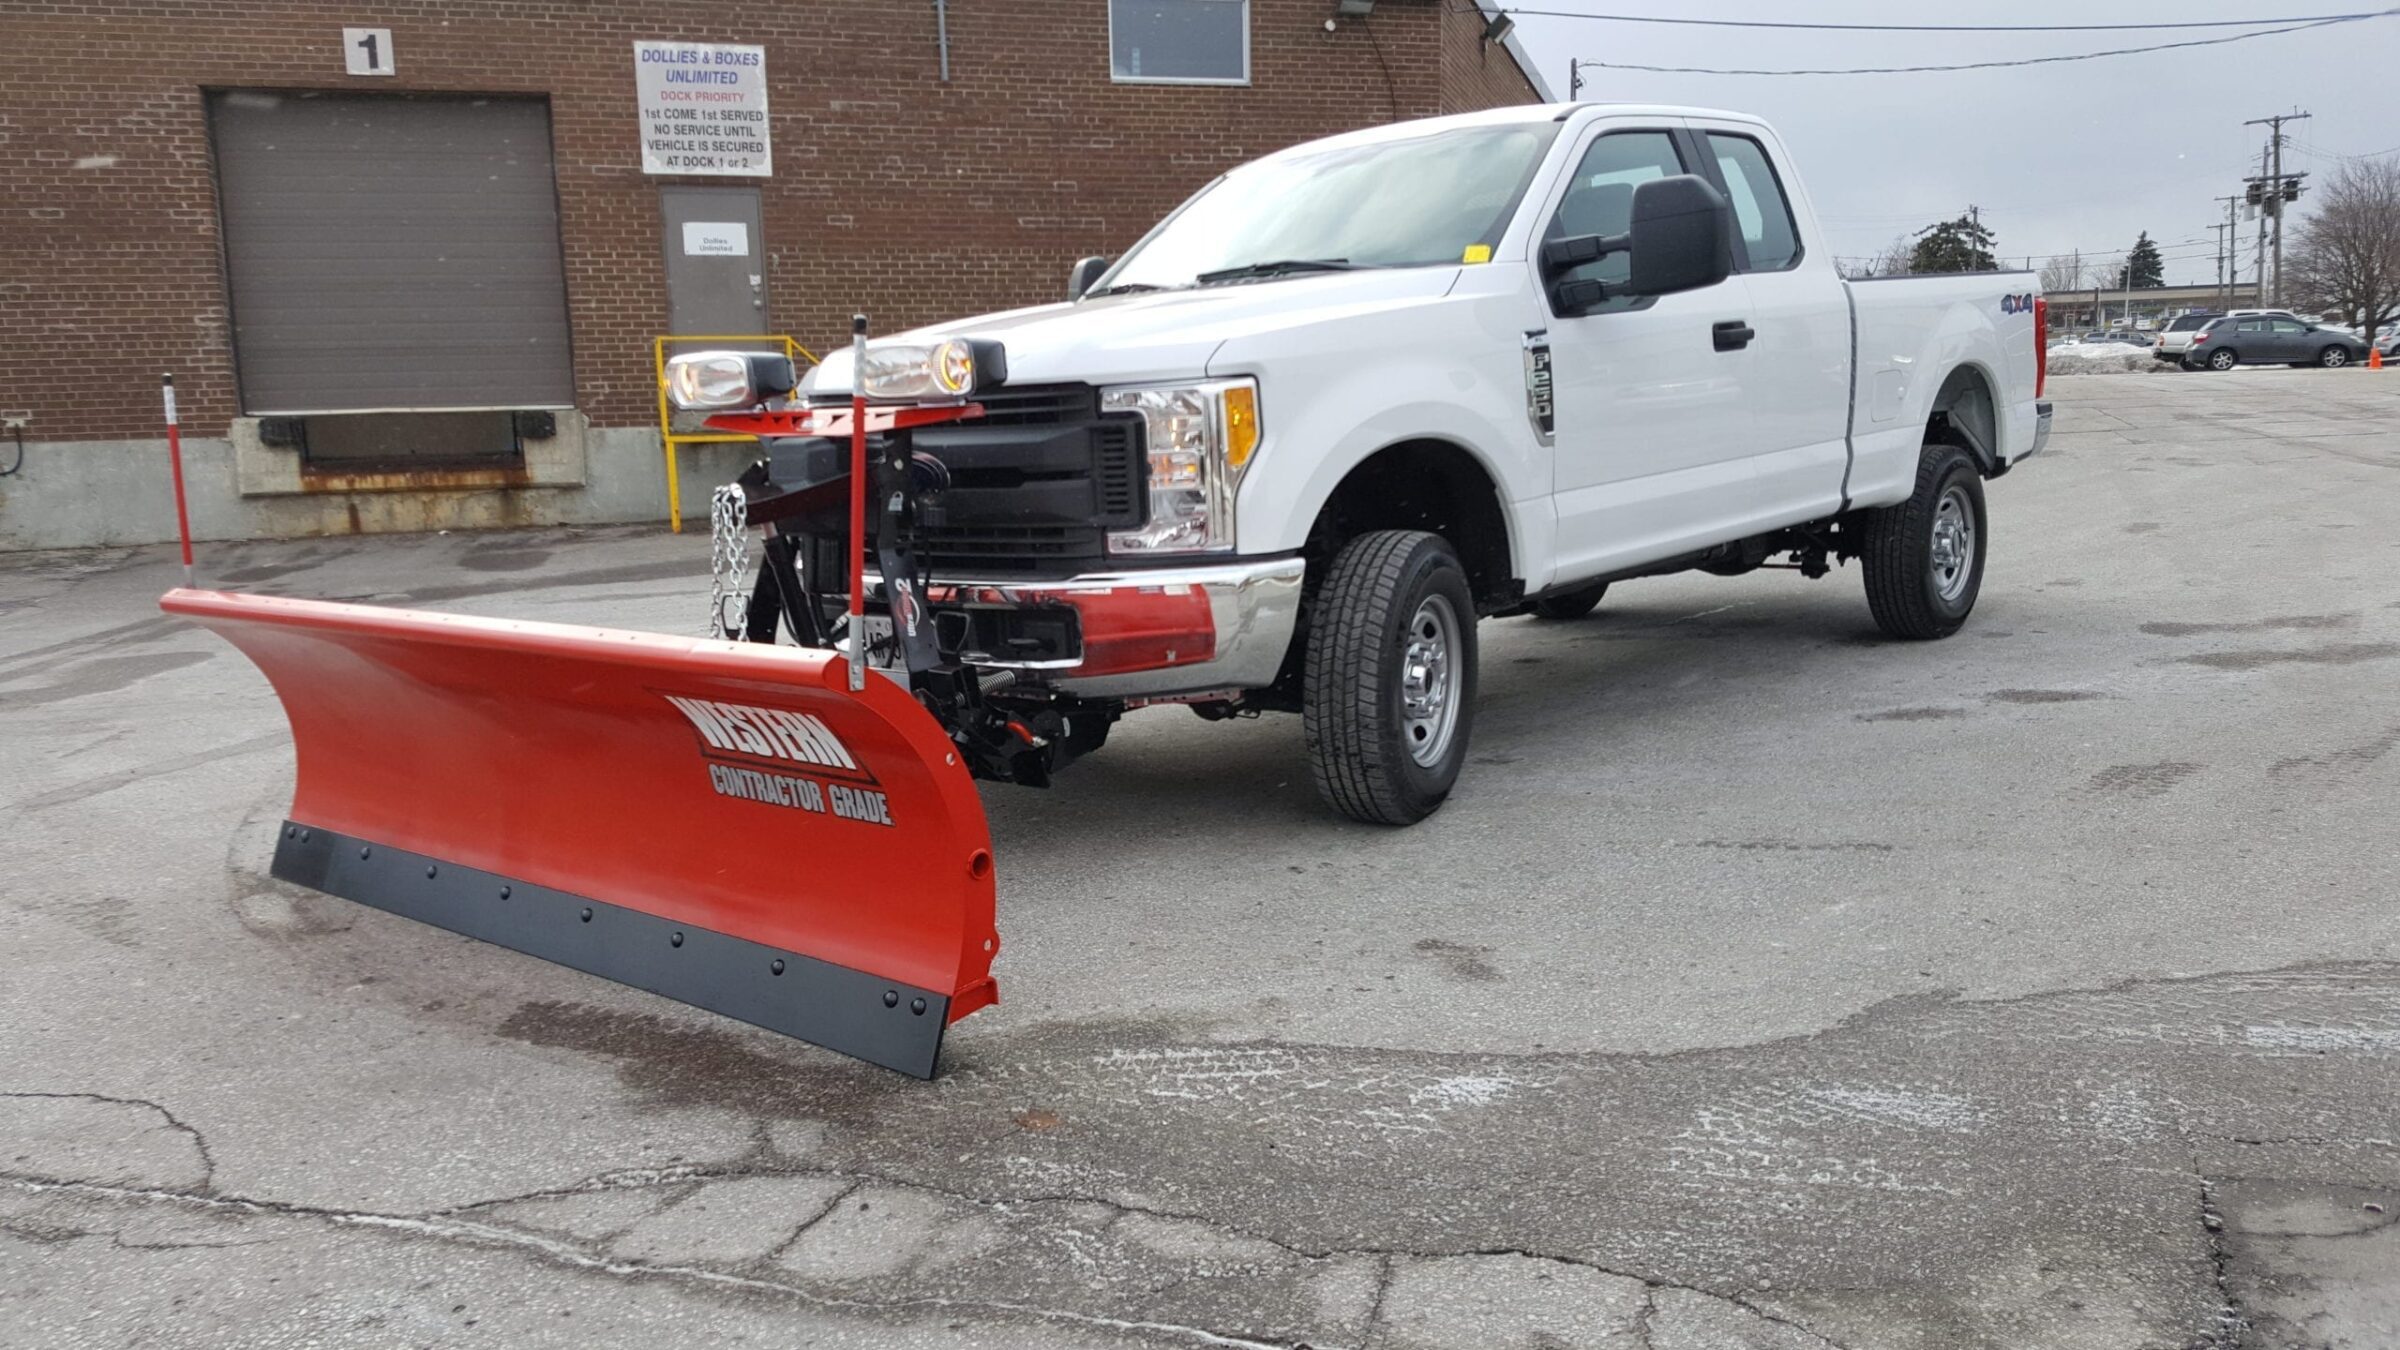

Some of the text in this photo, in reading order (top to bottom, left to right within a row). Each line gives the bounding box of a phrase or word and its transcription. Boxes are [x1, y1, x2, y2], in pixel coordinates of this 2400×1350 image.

[358, 34, 379, 69] 1
[641, 49, 759, 66] DOLLIES & BOXES
[666, 69, 739, 85] UNLIMITED
[660, 90, 745, 102] DOCK PRIORITY
[645, 108, 764, 122] 1st COME 1st SERVED
[654, 124, 756, 137] NO SERVICE UNTIL
[647, 139, 764, 153] VEHICLE IS SECURED
[666, 156, 749, 168] AT DOCK 1 or 2
[703, 237, 728, 245] Dollies
[664, 695, 857, 771] WESTERN
[707, 763, 893, 826] CONTRACTOR GRADE
